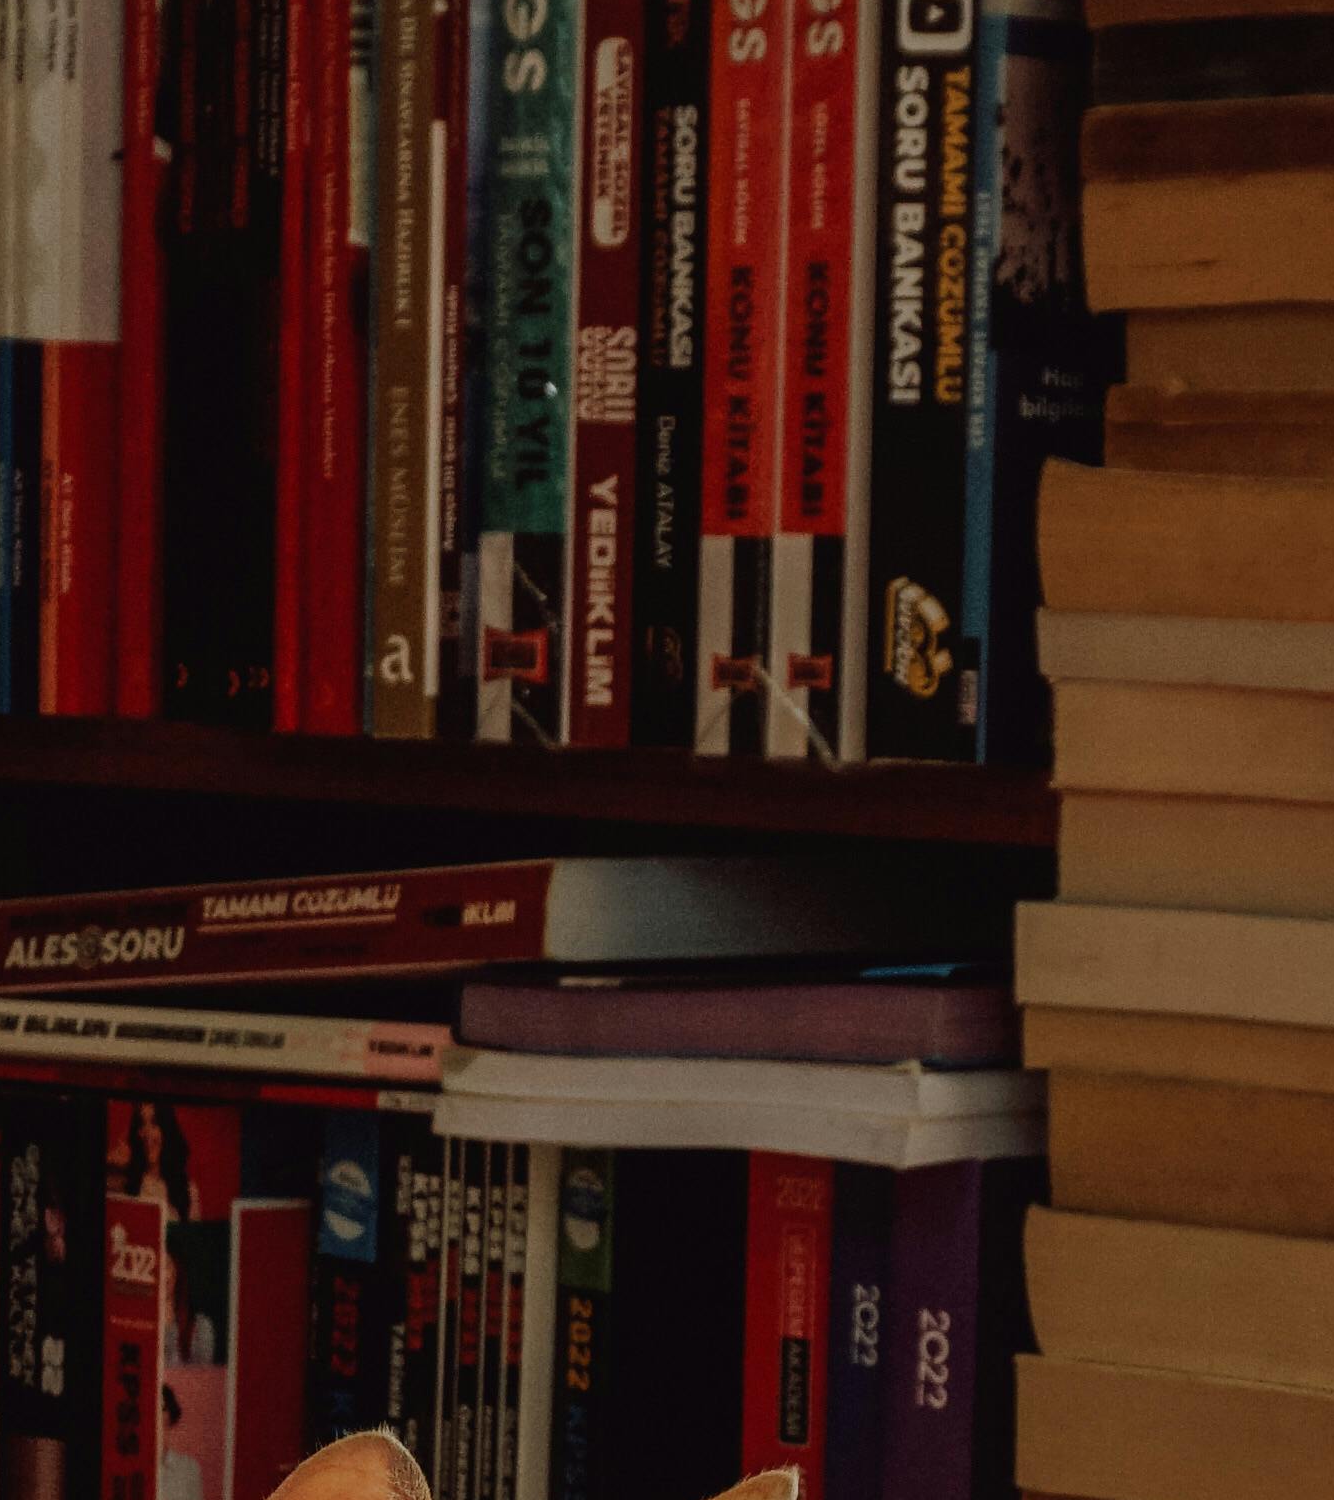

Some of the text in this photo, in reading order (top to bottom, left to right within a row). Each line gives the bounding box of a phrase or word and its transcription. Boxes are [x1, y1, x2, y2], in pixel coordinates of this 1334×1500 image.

[398, 16, 416, 56] DİL
[938, 66, 971, 218] TAMAMI
[669, 104, 699, 368] SORU BANKASI
[888, 63, 930, 405] SORU BANKASI
[514, 197, 556, 490] SON 10 YIL
[727, 266, 753, 380] KONU
[804, 261, 829, 378] KONU
[389, 385, 410, 445] ENES
[727, 394, 750, 520] KİTABI
[802, 392, 827, 518] KİTABI
[655, 413, 679, 571] Deniz ATALAY
[378, 632, 415, 688] a
[3, 889, 287, 972] ALES SORU TAMAMI
[410, 1173, 430, 1262] KPSS
[465, 1186, 482, 1275] KPSS
[566, 1295, 595, 1392] 2022
[851, 1283, 881, 1368] 2022
[916, 1307, 952, 1410] 2022
